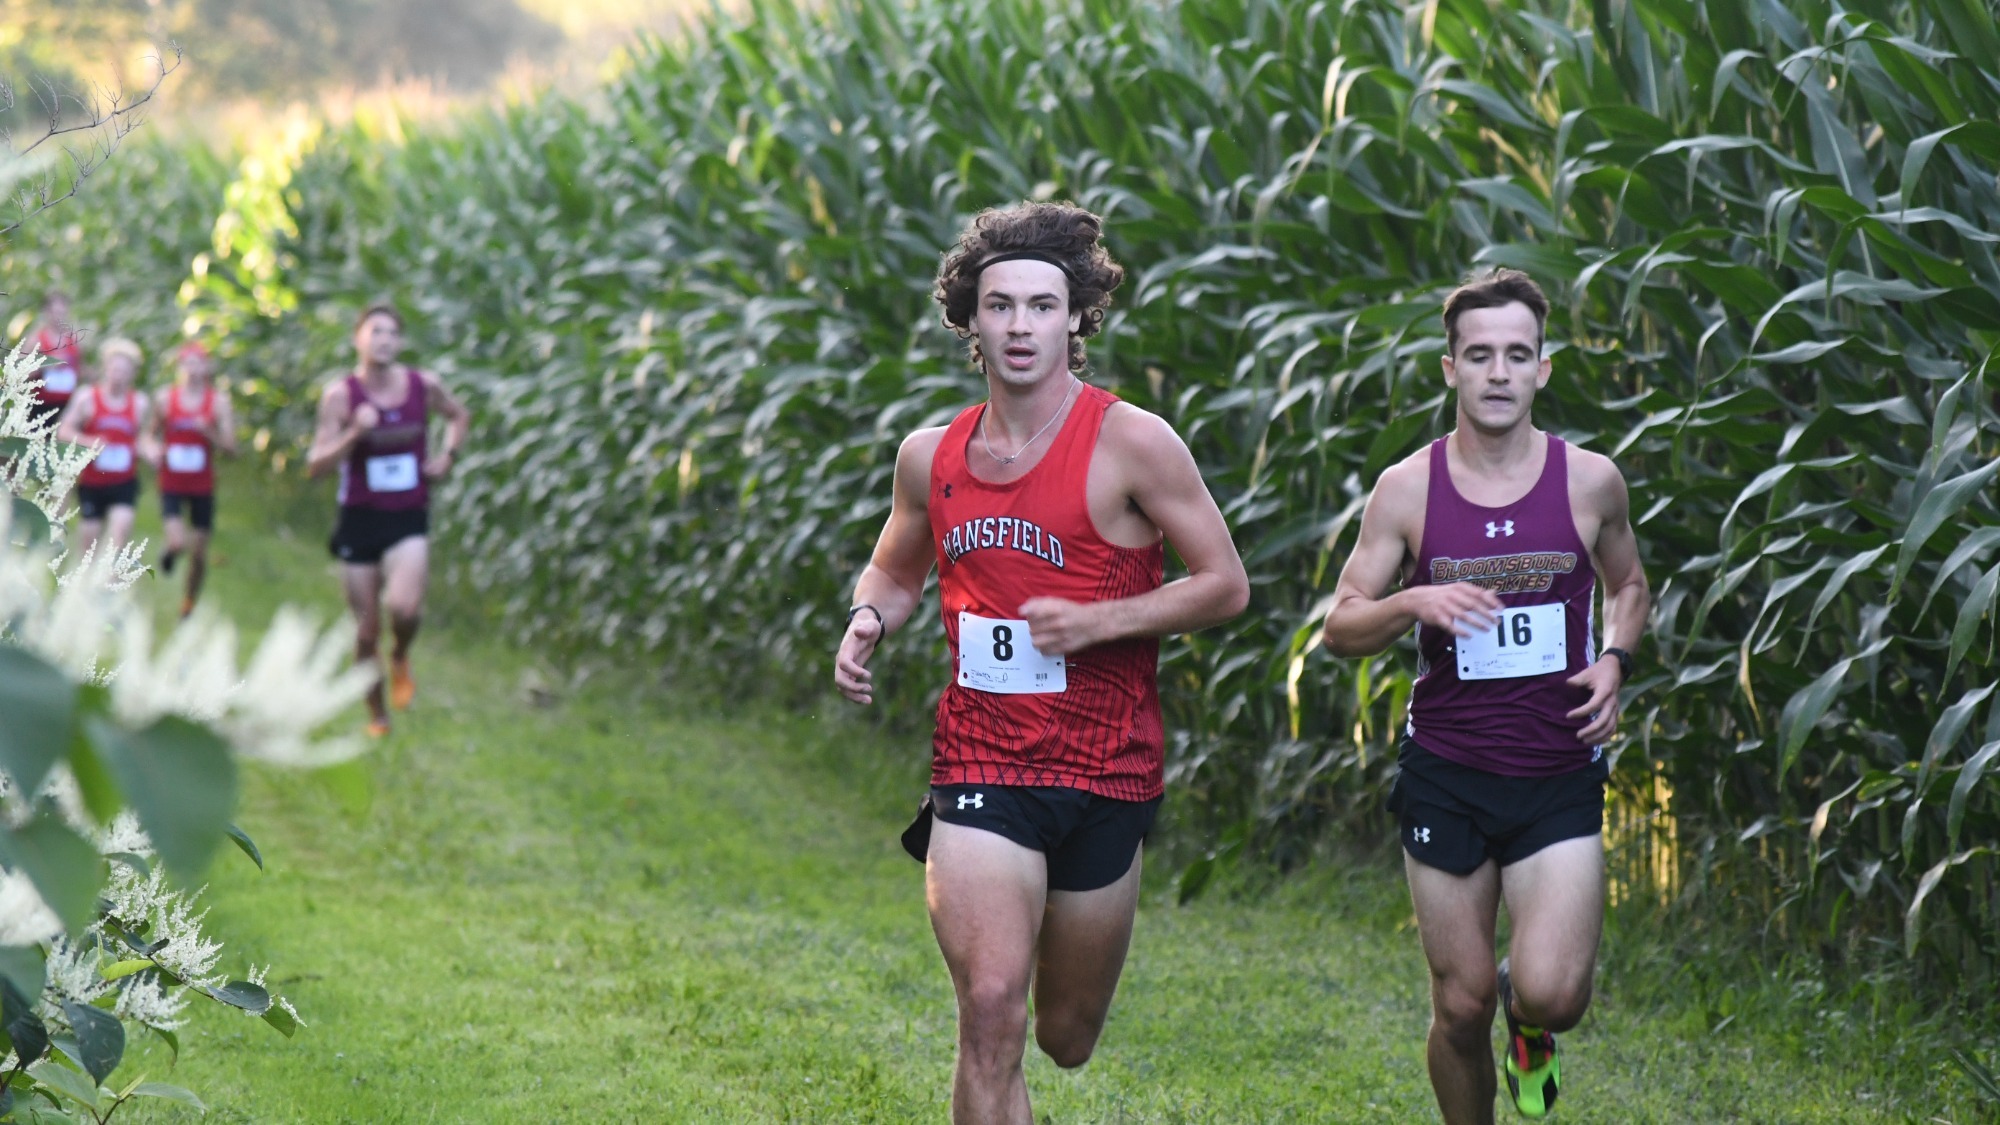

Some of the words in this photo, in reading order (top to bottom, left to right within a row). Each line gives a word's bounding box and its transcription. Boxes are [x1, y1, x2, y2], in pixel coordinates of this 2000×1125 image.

[942, 516, 1065, 568] MANSFIELD
[1466, 574, 1552, 593] USKIES
[992, 625, 1013, 661] 8
[1496, 613, 1532, 648] 16
